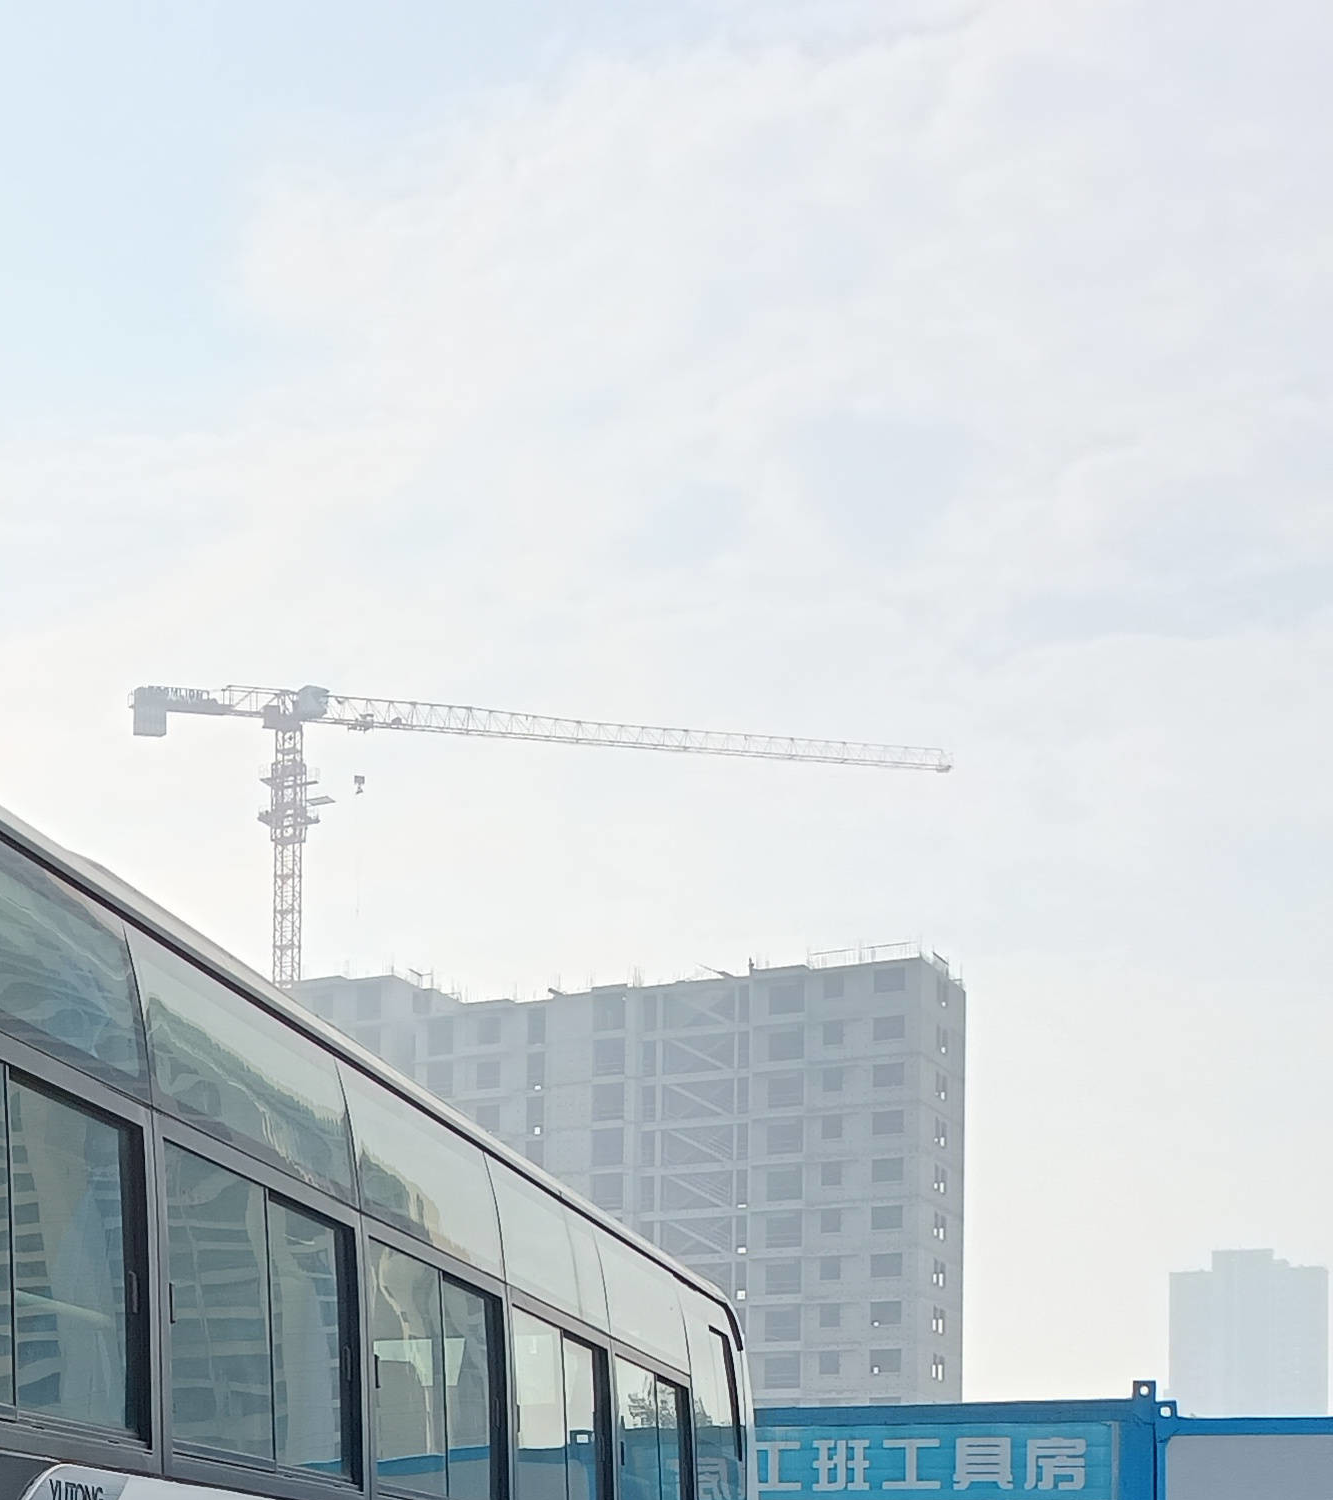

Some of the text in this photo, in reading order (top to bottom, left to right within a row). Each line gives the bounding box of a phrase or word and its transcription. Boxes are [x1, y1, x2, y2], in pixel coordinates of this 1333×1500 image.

[755, 1436, 1088, 1492] 工班工具房
